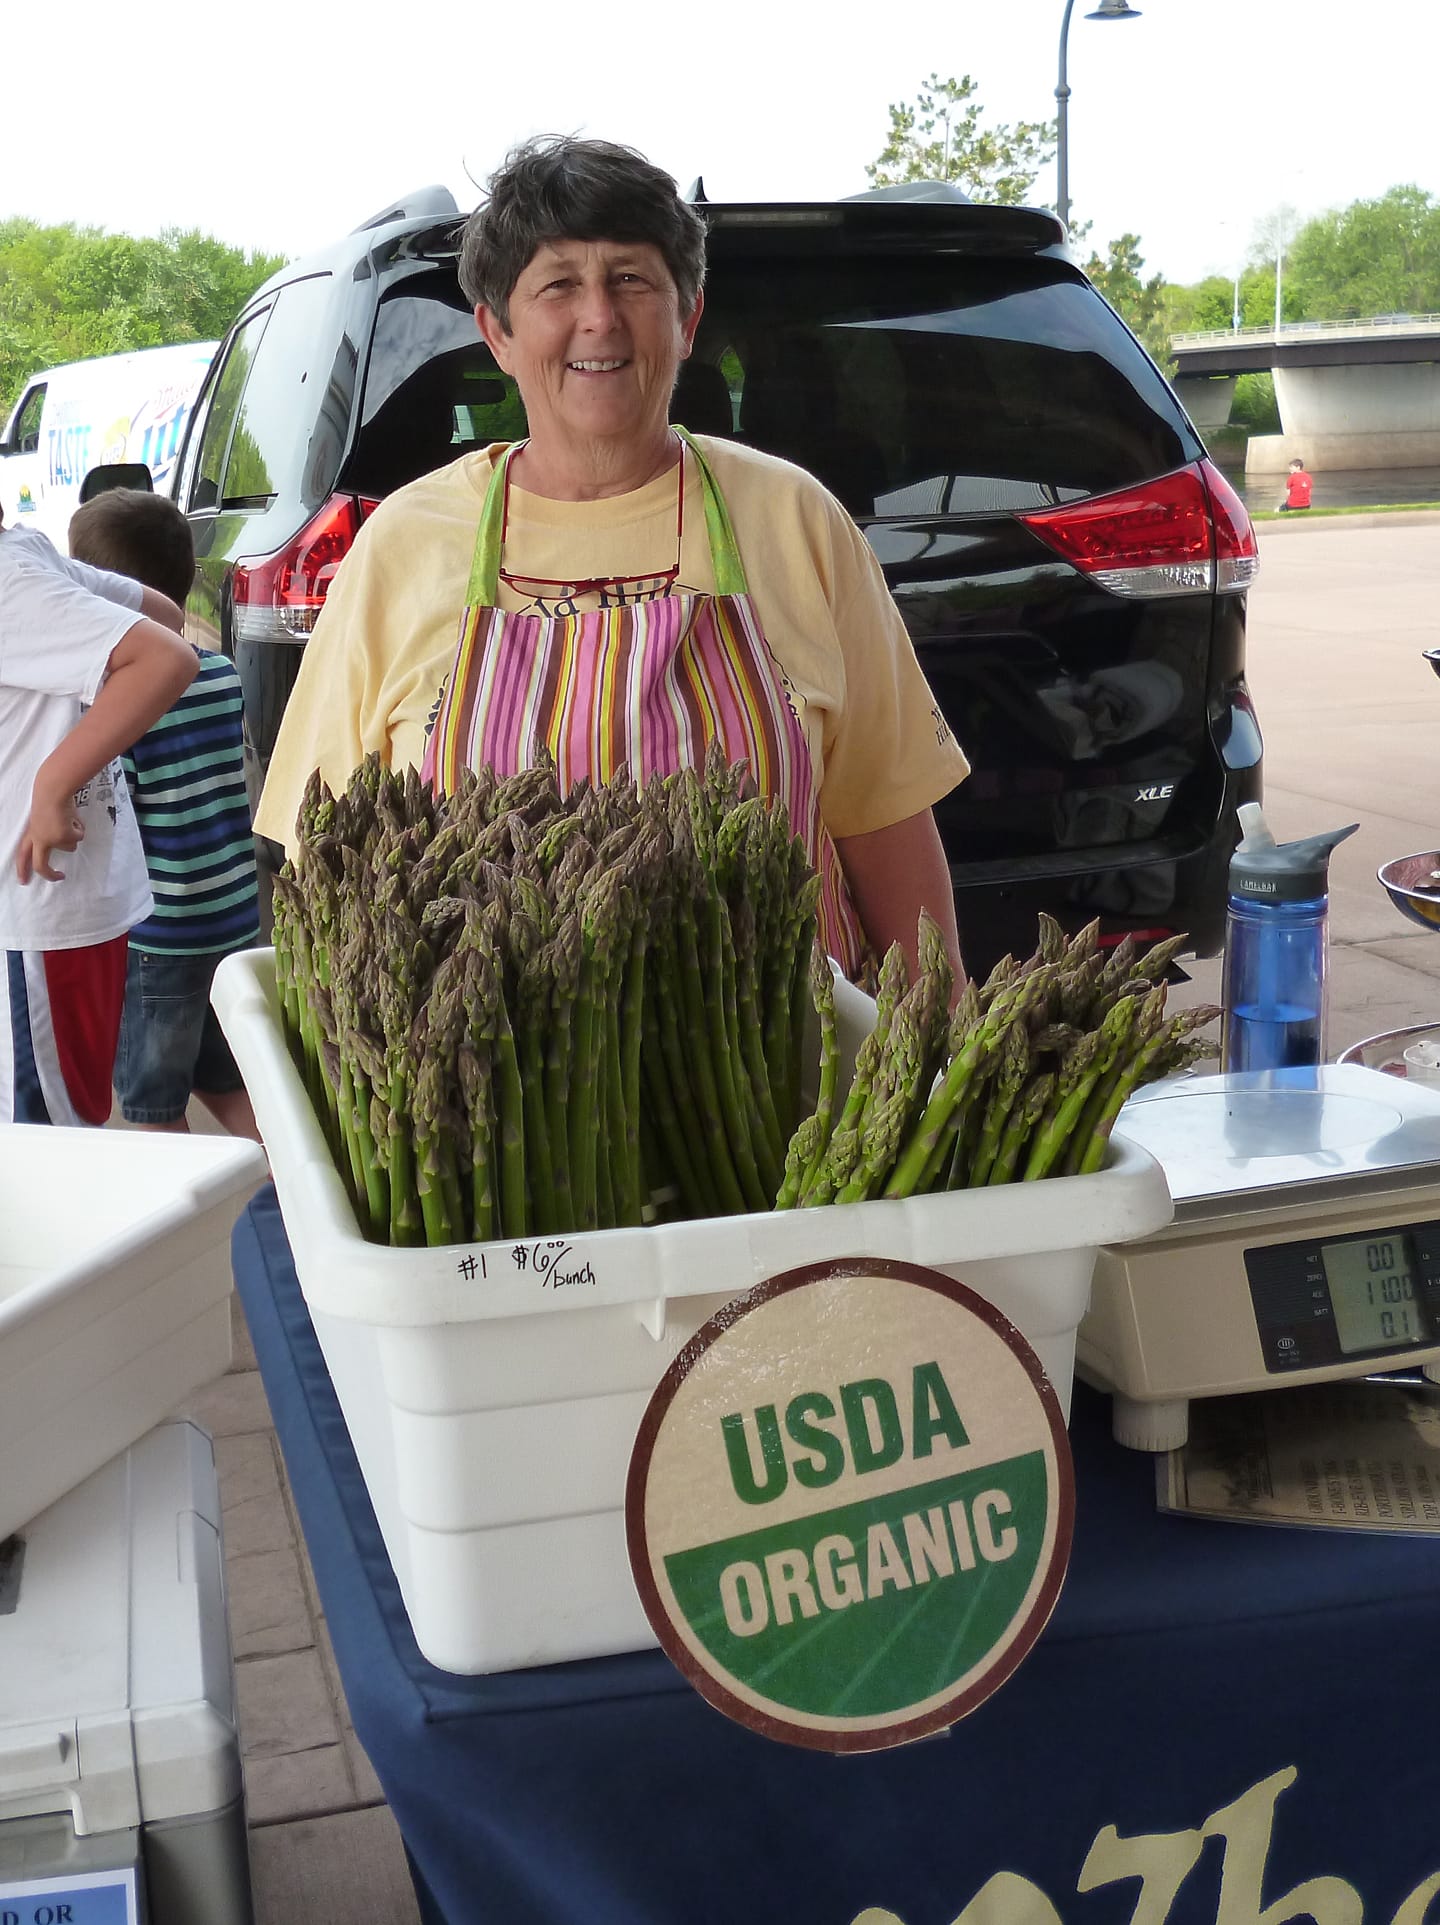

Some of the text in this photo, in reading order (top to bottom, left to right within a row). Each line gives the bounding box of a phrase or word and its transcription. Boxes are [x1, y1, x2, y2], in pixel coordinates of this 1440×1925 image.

[1134, 785, 1173, 801] XLE
[457, 1254, 487, 1280] #1
[720, 1361, 971, 1505] USDA
[719, 1489, 1018, 1638] ORGANIC
[34, 1904, 73, 1925] OR
